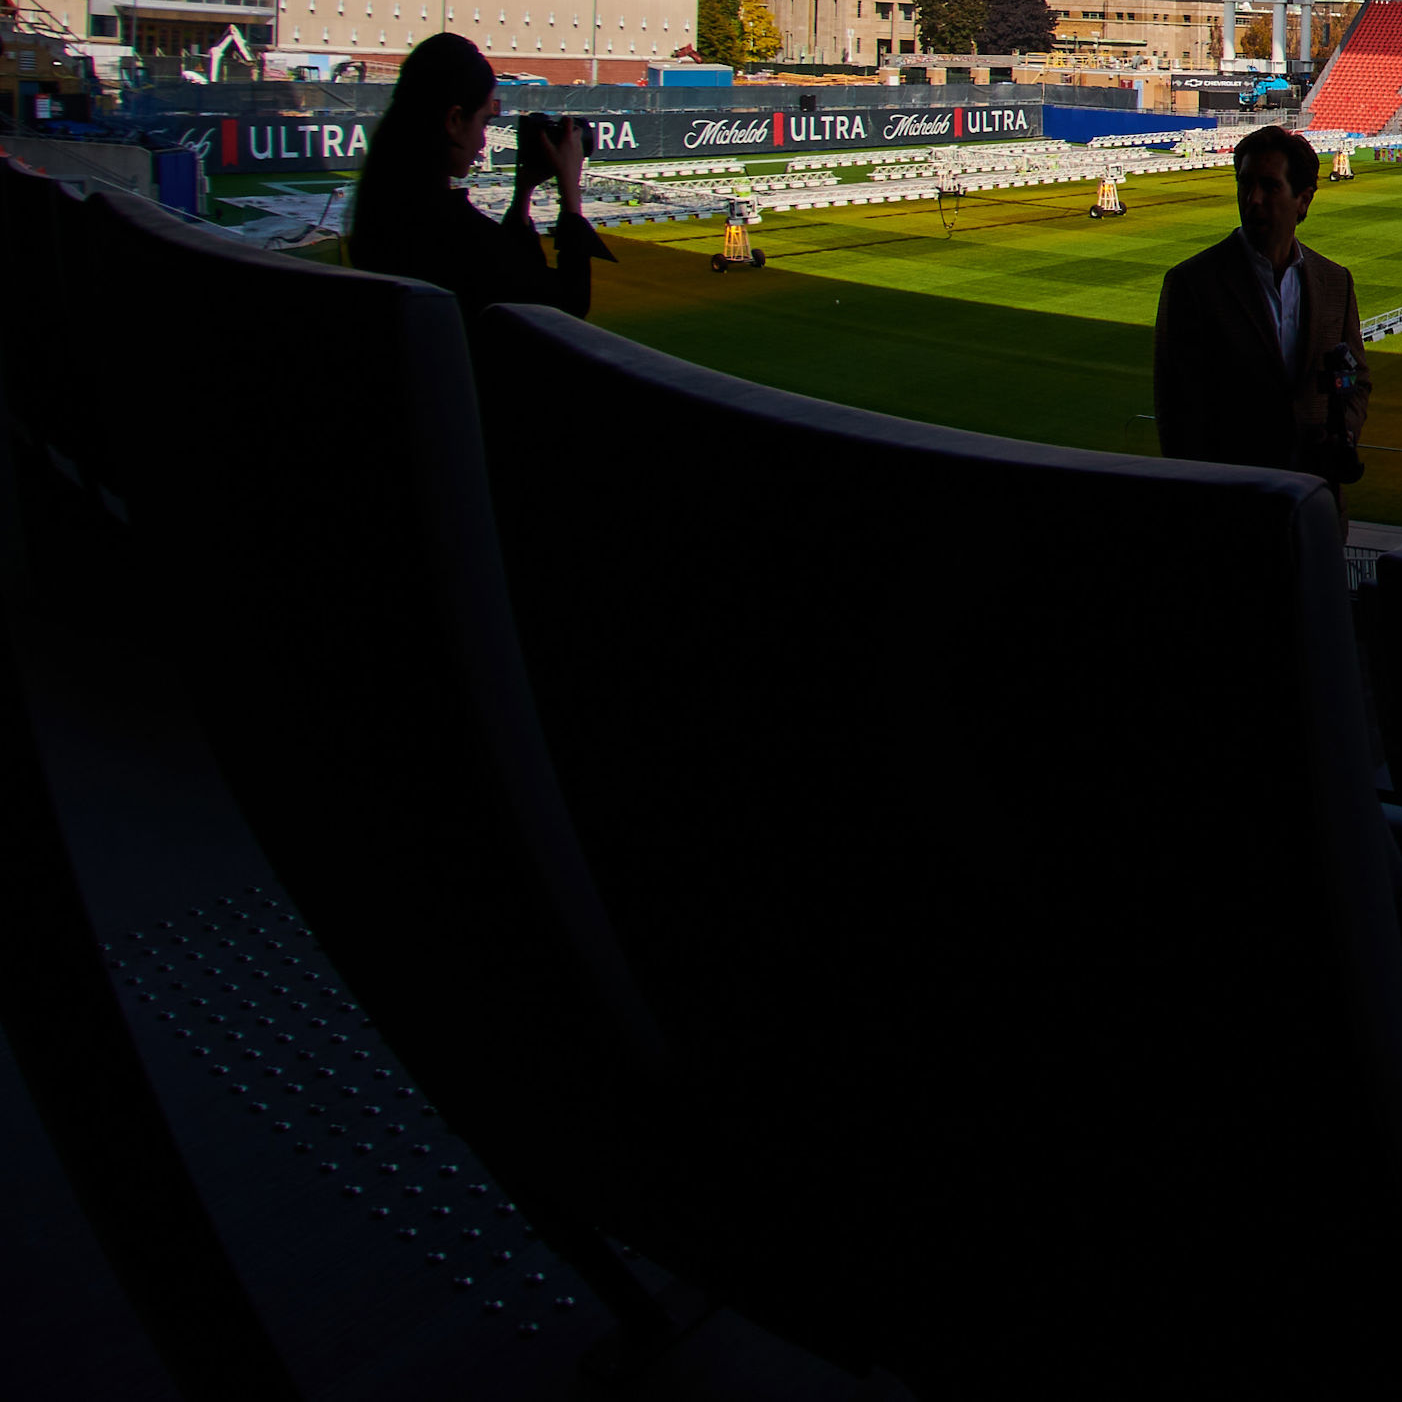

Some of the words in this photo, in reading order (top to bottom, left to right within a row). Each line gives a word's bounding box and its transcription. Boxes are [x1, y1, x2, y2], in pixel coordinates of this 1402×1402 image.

[249, 124, 368, 160] ULTRA
[684, 118, 770, 148] Michelob
[790, 115, 866, 142] ULTRA
[883, 113, 952, 140] Michelob
[967, 109, 1029, 133] ULTRA
